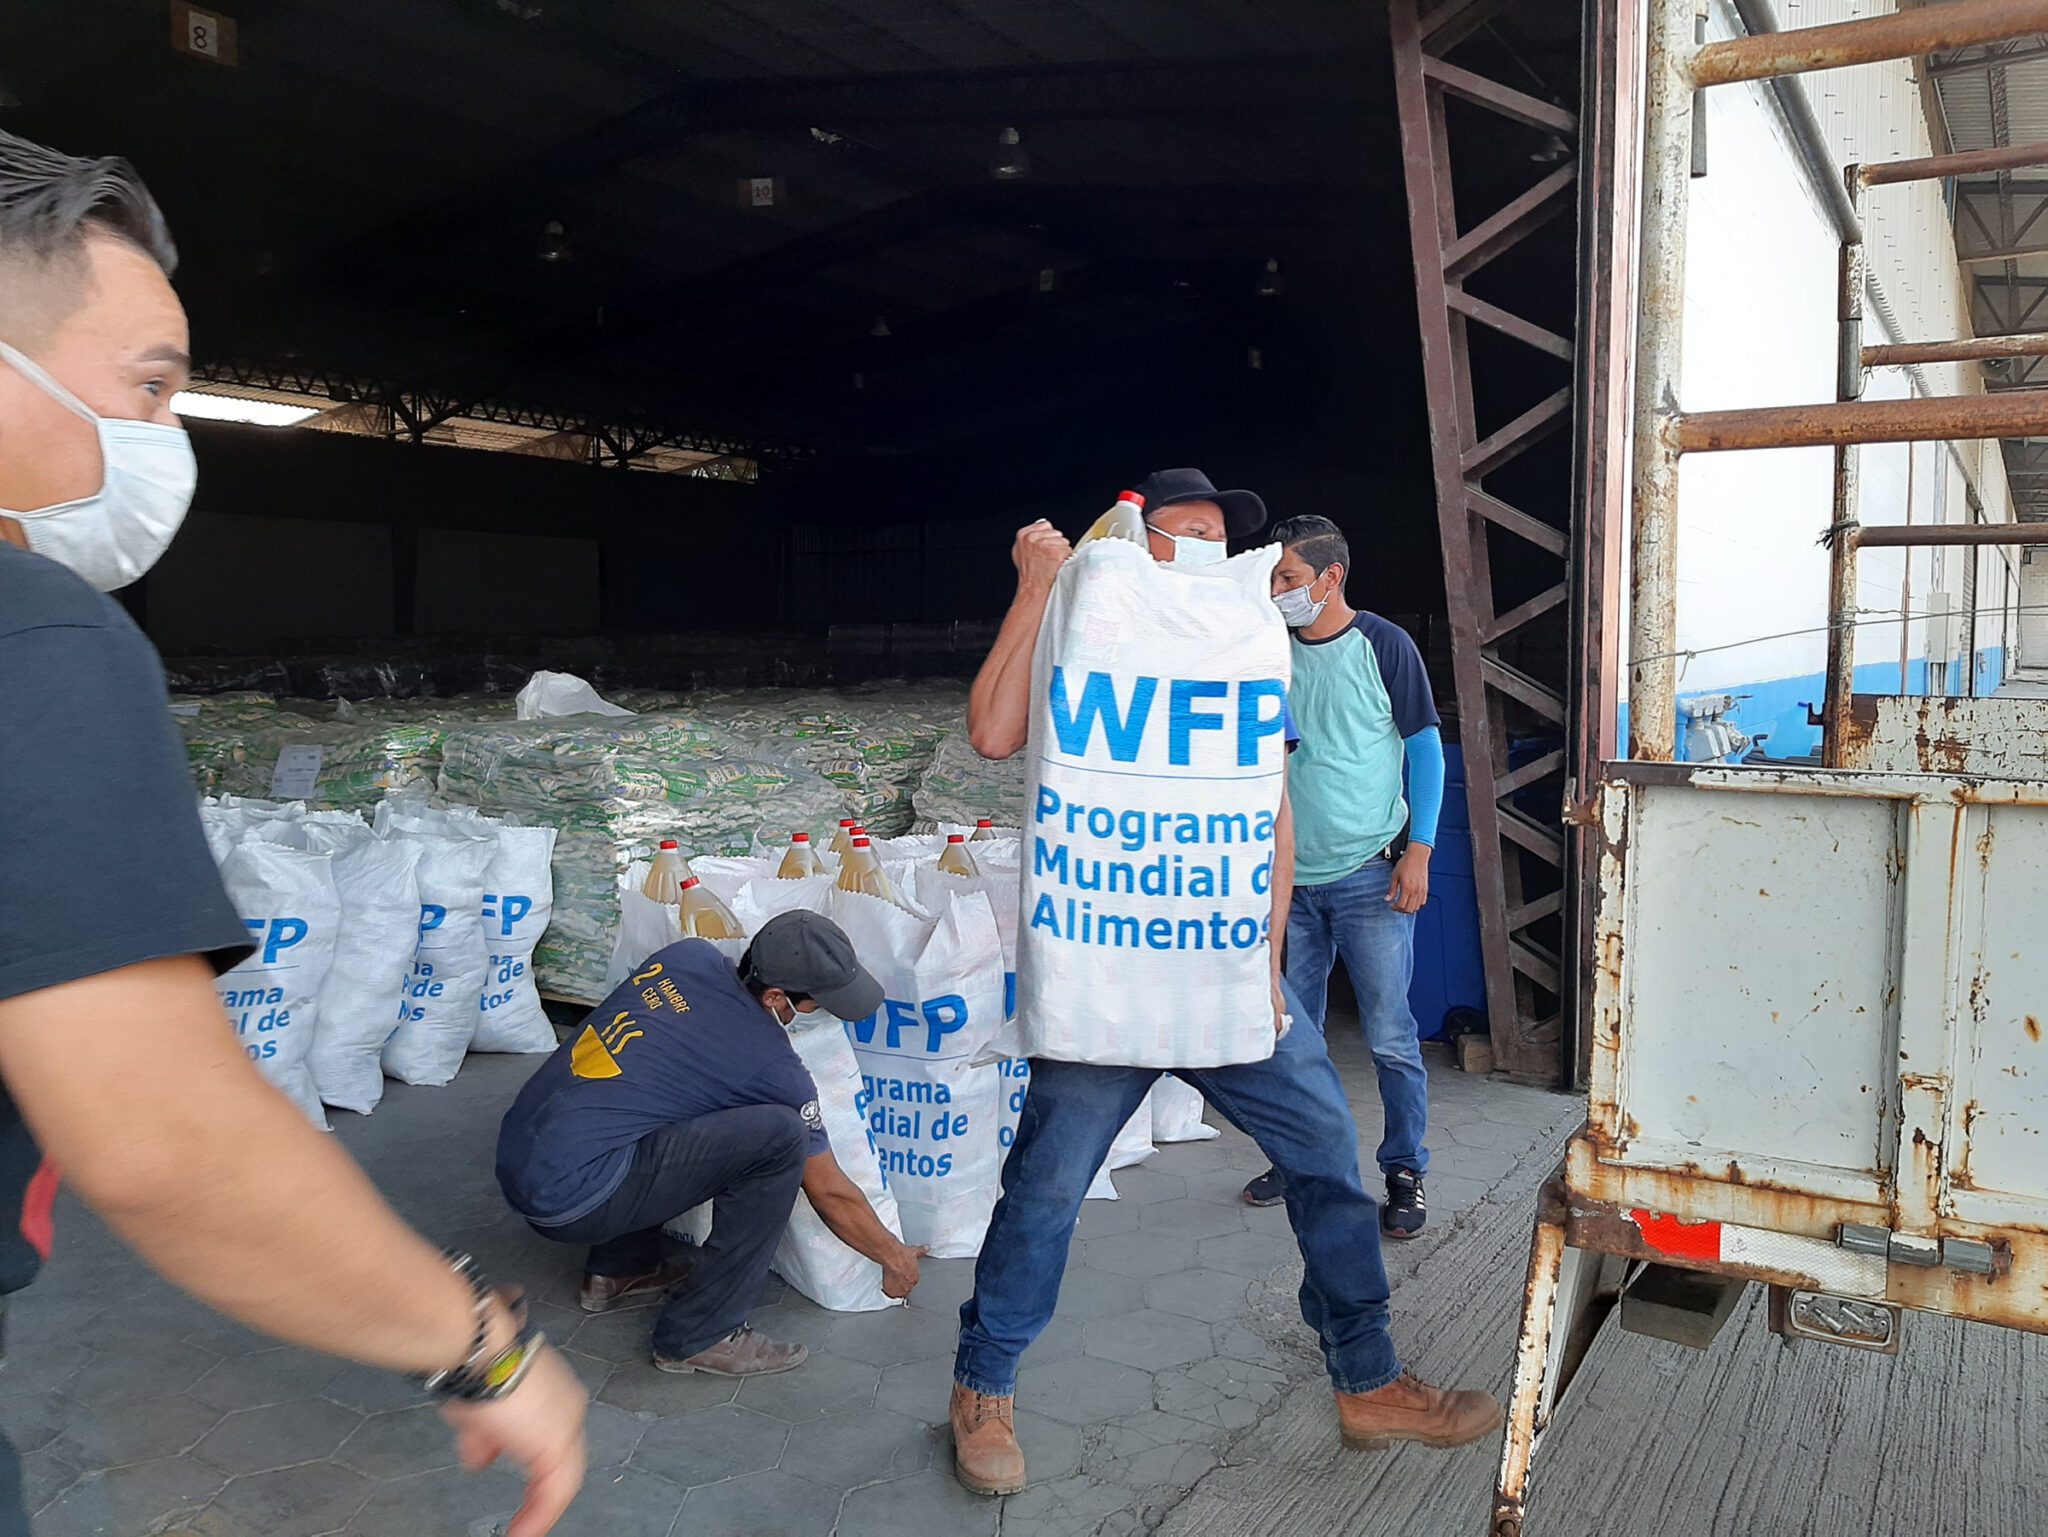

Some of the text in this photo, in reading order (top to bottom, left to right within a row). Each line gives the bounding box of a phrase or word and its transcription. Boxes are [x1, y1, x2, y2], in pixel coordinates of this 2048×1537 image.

[193, 26, 207, 49] 8
[1050, 665, 1286, 767] WFP
[1035, 783, 1274, 851] Programa
[1034, 836, 1230, 897] Mundial
[498, 961, 524, 984] de
[632, 962, 664, 986] 2
[217, 987, 285, 1009] ama
[411, 979, 444, 998] de
[641, 987, 664, 1010] CERO
[657, 977, 690, 1013] HAMBRE
[258, 1008, 290, 1033] de
[870, 1105, 968, 1141] dial de
